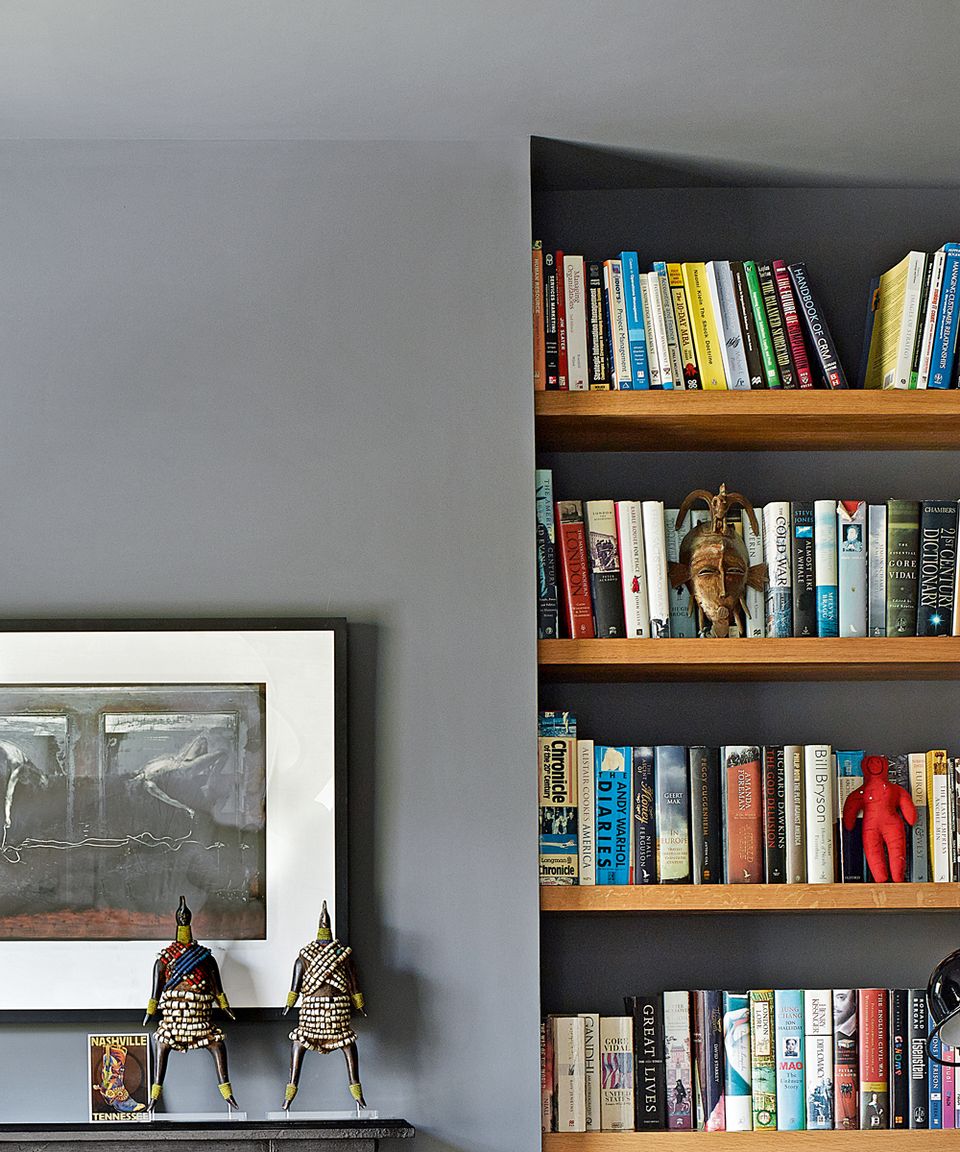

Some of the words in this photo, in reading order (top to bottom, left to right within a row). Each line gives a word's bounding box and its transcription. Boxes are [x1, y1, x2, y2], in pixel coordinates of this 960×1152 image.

[693, 269, 701, 289] Naomi
[794, 269, 818, 324] HANDBOOK
[697, 290, 705, 306] Klein
[616, 308, 626, 331] Project
[702, 319, 710, 338] Shock
[812, 323, 825, 339] OF
[619, 332, 628, 374] Management
[705, 340, 714, 365] Doctrine
[817, 338, 832, 361] CRM
[567, 490, 583, 559] LONDON
[924, 506, 956, 514] CHAMBERS
[776, 516, 787, 554] COLD
[776, 556, 787, 586] WAR
[797, 557, 805, 583] WHALE
[804, 540, 812, 570] ALMOST
[889, 560, 917, 568] GORE
[920, 528, 940, 609] DICTIONARY
[889, 572, 917, 580] VIDAL
[938, 550, 956, 610] CENTURY
[551, 740, 567, 804] Chronicle
[598, 771, 628, 779] THE
[776, 750, 785, 796] RICHARD
[814, 750, 828, 771] Bill
[543, 776, 551, 800] Century
[616, 781, 628, 816] ANDY
[738, 769, 746, 811] FOREMAN
[744, 771, 753, 810] AMANDA
[813, 774, 828, 823] Bryson
[597, 781, 613, 868] DIARIES
[776, 801, 786, 849] DAWKINS
[615, 817, 627, 870] WARHOL
[639, 826, 648, 868] FERGUSON
[91, 1035, 148, 1047] NASHVILLE
[585, 1016, 594, 1074] GANDHI
[643, 1004, 656, 1057] GREAT
[779, 1062, 803, 1070] MAO
[816, 1038, 824, 1079] DIPLOMACY
[911, 1038, 927, 1081] Eisenstein
[644, 1067, 656, 1113] LIVES
[92, 1112, 150, 1121] TENNESSEE
